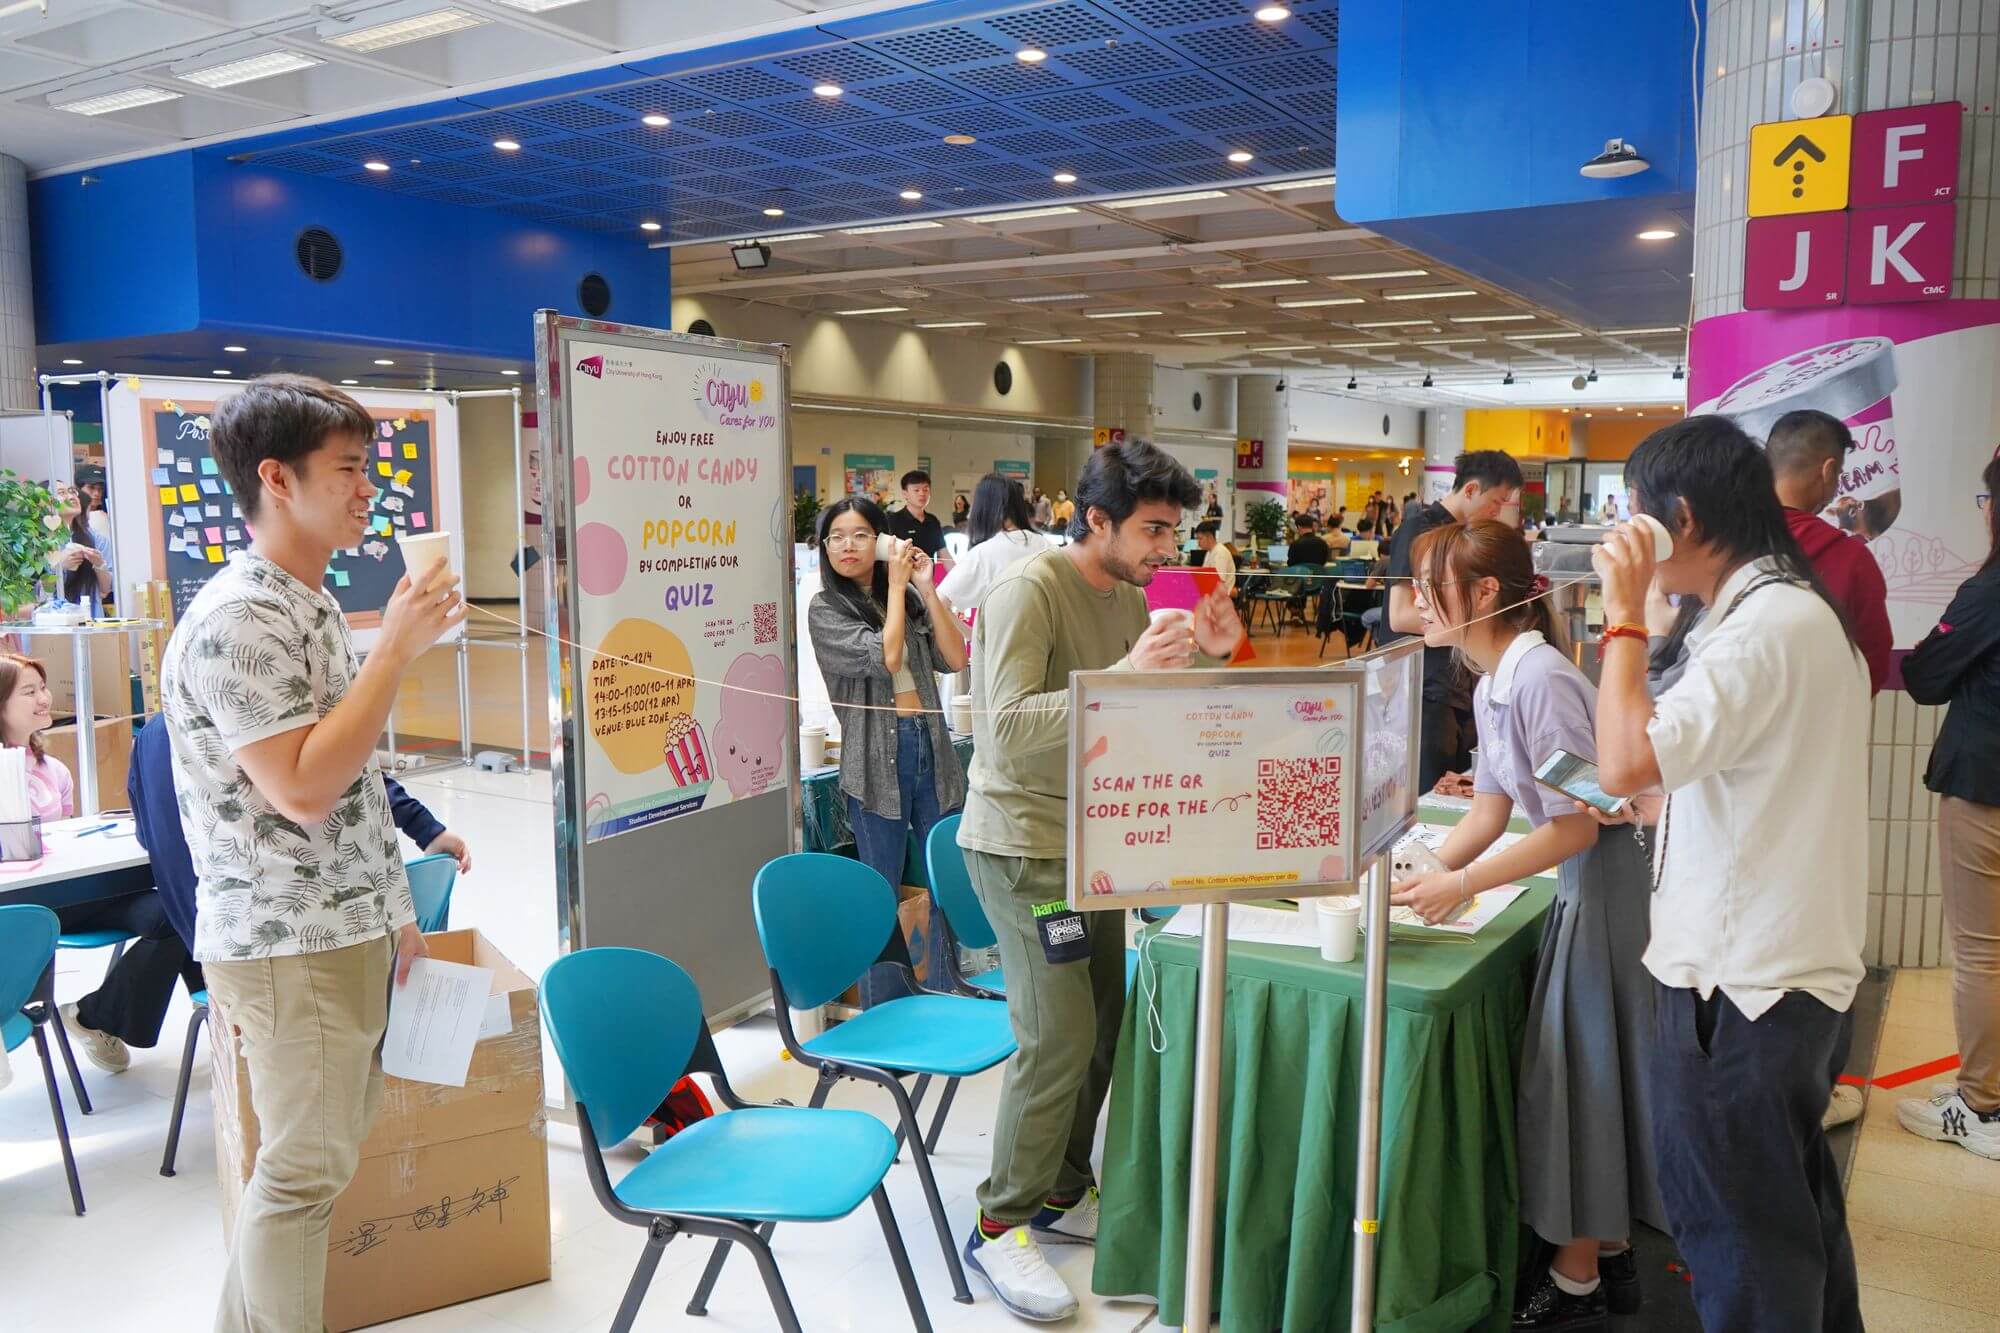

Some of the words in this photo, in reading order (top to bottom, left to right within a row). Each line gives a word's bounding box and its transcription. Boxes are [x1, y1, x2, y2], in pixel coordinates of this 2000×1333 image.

[1883, 123, 1927, 189] F
[1934, 186, 1951, 197] JCT
[1778, 230, 1811, 292] J
[1870, 221, 1927, 286] K
[1825, 291, 1838, 301] SR
[1922, 285, 1946, 295] CMC
[720, 413, 742, 427] Cares
[742, 415, 757, 430] for
[758, 415, 775, 428] YOU
[656, 430, 687, 446] ENJOY
[690, 432, 714, 446] FREE
[607, 454, 688, 486] COTTON
[697, 456, 758, 486] CANDY
[678, 494, 692, 509] OR
[642, 517, 737, 550] POPCORN
[639, 559, 653, 574] BY
[655, 555, 717, 574] COMPLETING
[719, 555, 739, 570] OUR
[665, 582, 715, 611] QUIZ
[716, 629, 725, 637] FOR
[592, 658, 618, 671] DATE:
[619, 651, 652, 667] 10-12/4
[593, 674, 617, 688] TIME:
[676, 674, 695, 689] APR)
[594, 696, 659, 720] 13:15-15:00(12
[660, 693, 680, 707] APR)
[1185, 711, 1222, 721] COTTON
[1224, 710, 1255, 721] CANDY
[595, 721, 624, 736] VENUE:
[625, 716, 646, 730] BLUE
[648, 711, 670, 725] ZONE
[1200, 730, 1243, 740] POPCORN
[1208, 749, 1231, 758] QUIZ
[1091, 776, 1136, 793] SCAN
[1142, 774, 1173, 790] THE
[1179, 773, 1204, 789] QR
[628, 815, 648, 826] Student
[648, 806, 680, 820] Development
[679, 800, 699, 812] Services
[1086, 802, 1129, 819] CODE
[1137, 800, 1171, 818] FOR
[1178, 799, 1209, 816] THE
[1124, 823, 1173, 847] QUIZ!
